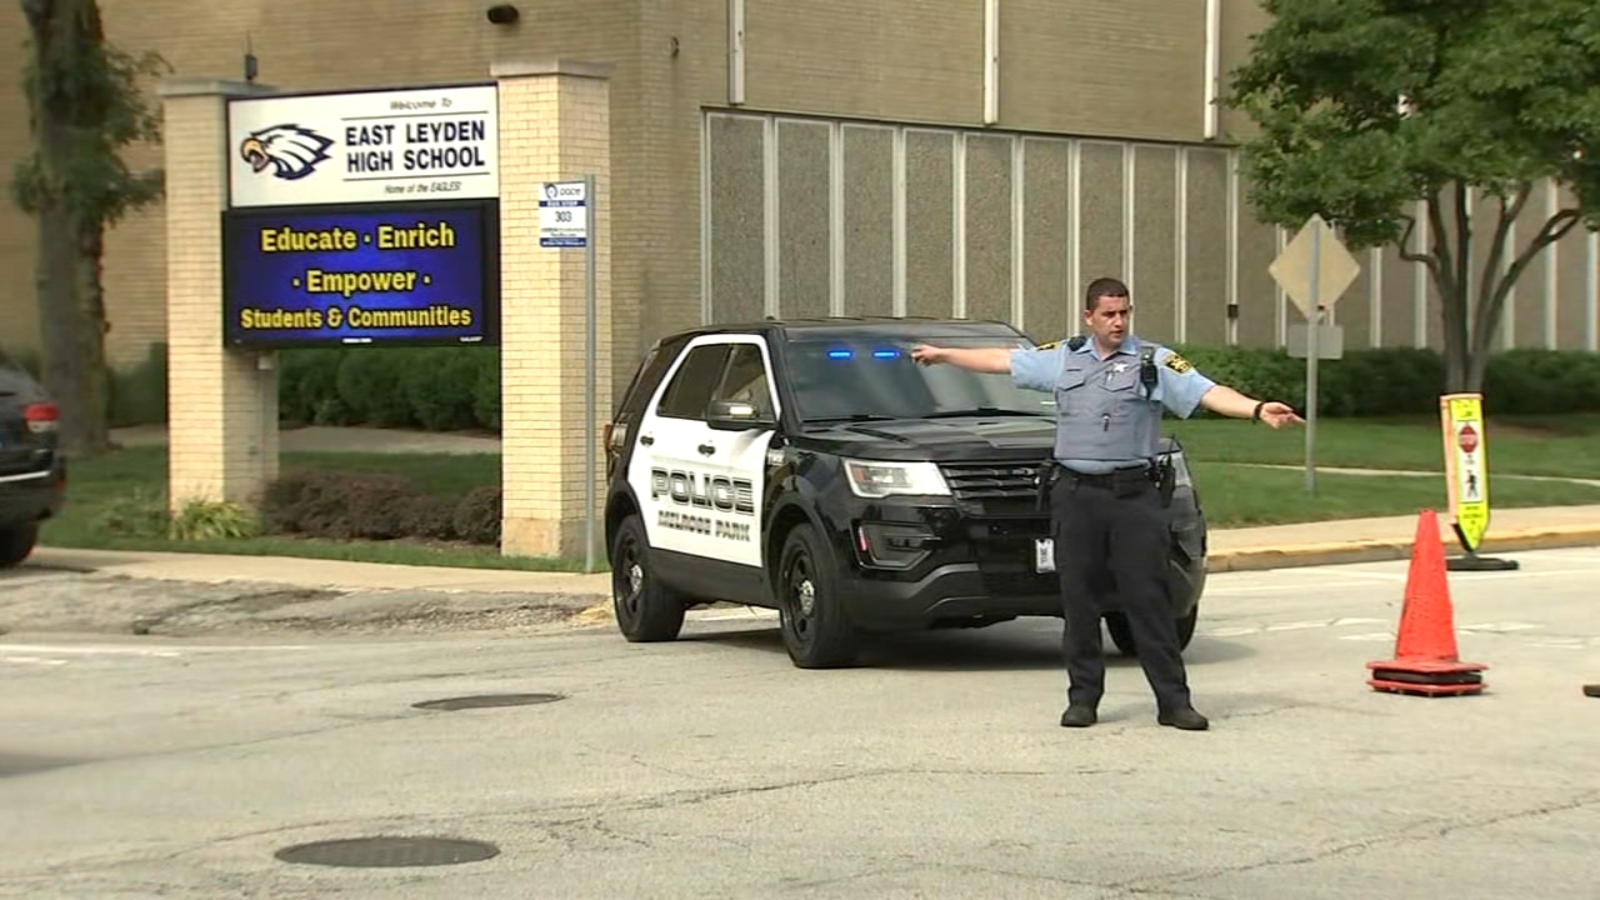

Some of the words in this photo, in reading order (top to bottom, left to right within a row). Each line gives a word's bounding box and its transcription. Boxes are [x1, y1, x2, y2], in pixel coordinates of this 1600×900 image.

[389, 100, 437, 110] Welcome
[346, 125, 395, 146] EAST
[406, 120, 485, 143] LEYDEN
[347, 150, 393, 172] HIGH
[403, 146, 485, 170] SCHOOL
[555, 210, 572, 223] 303
[261, 227, 357, 251] Educate
[378, 222, 454, 248] Enrich
[306, 269, 416, 298] Empower
[240, 308, 323, 328] Students
[327, 307, 342, 327] &
[348, 305, 472, 327] Communities
[651, 466, 754, 516] POLICE
[715, 519, 751, 542] PARK
